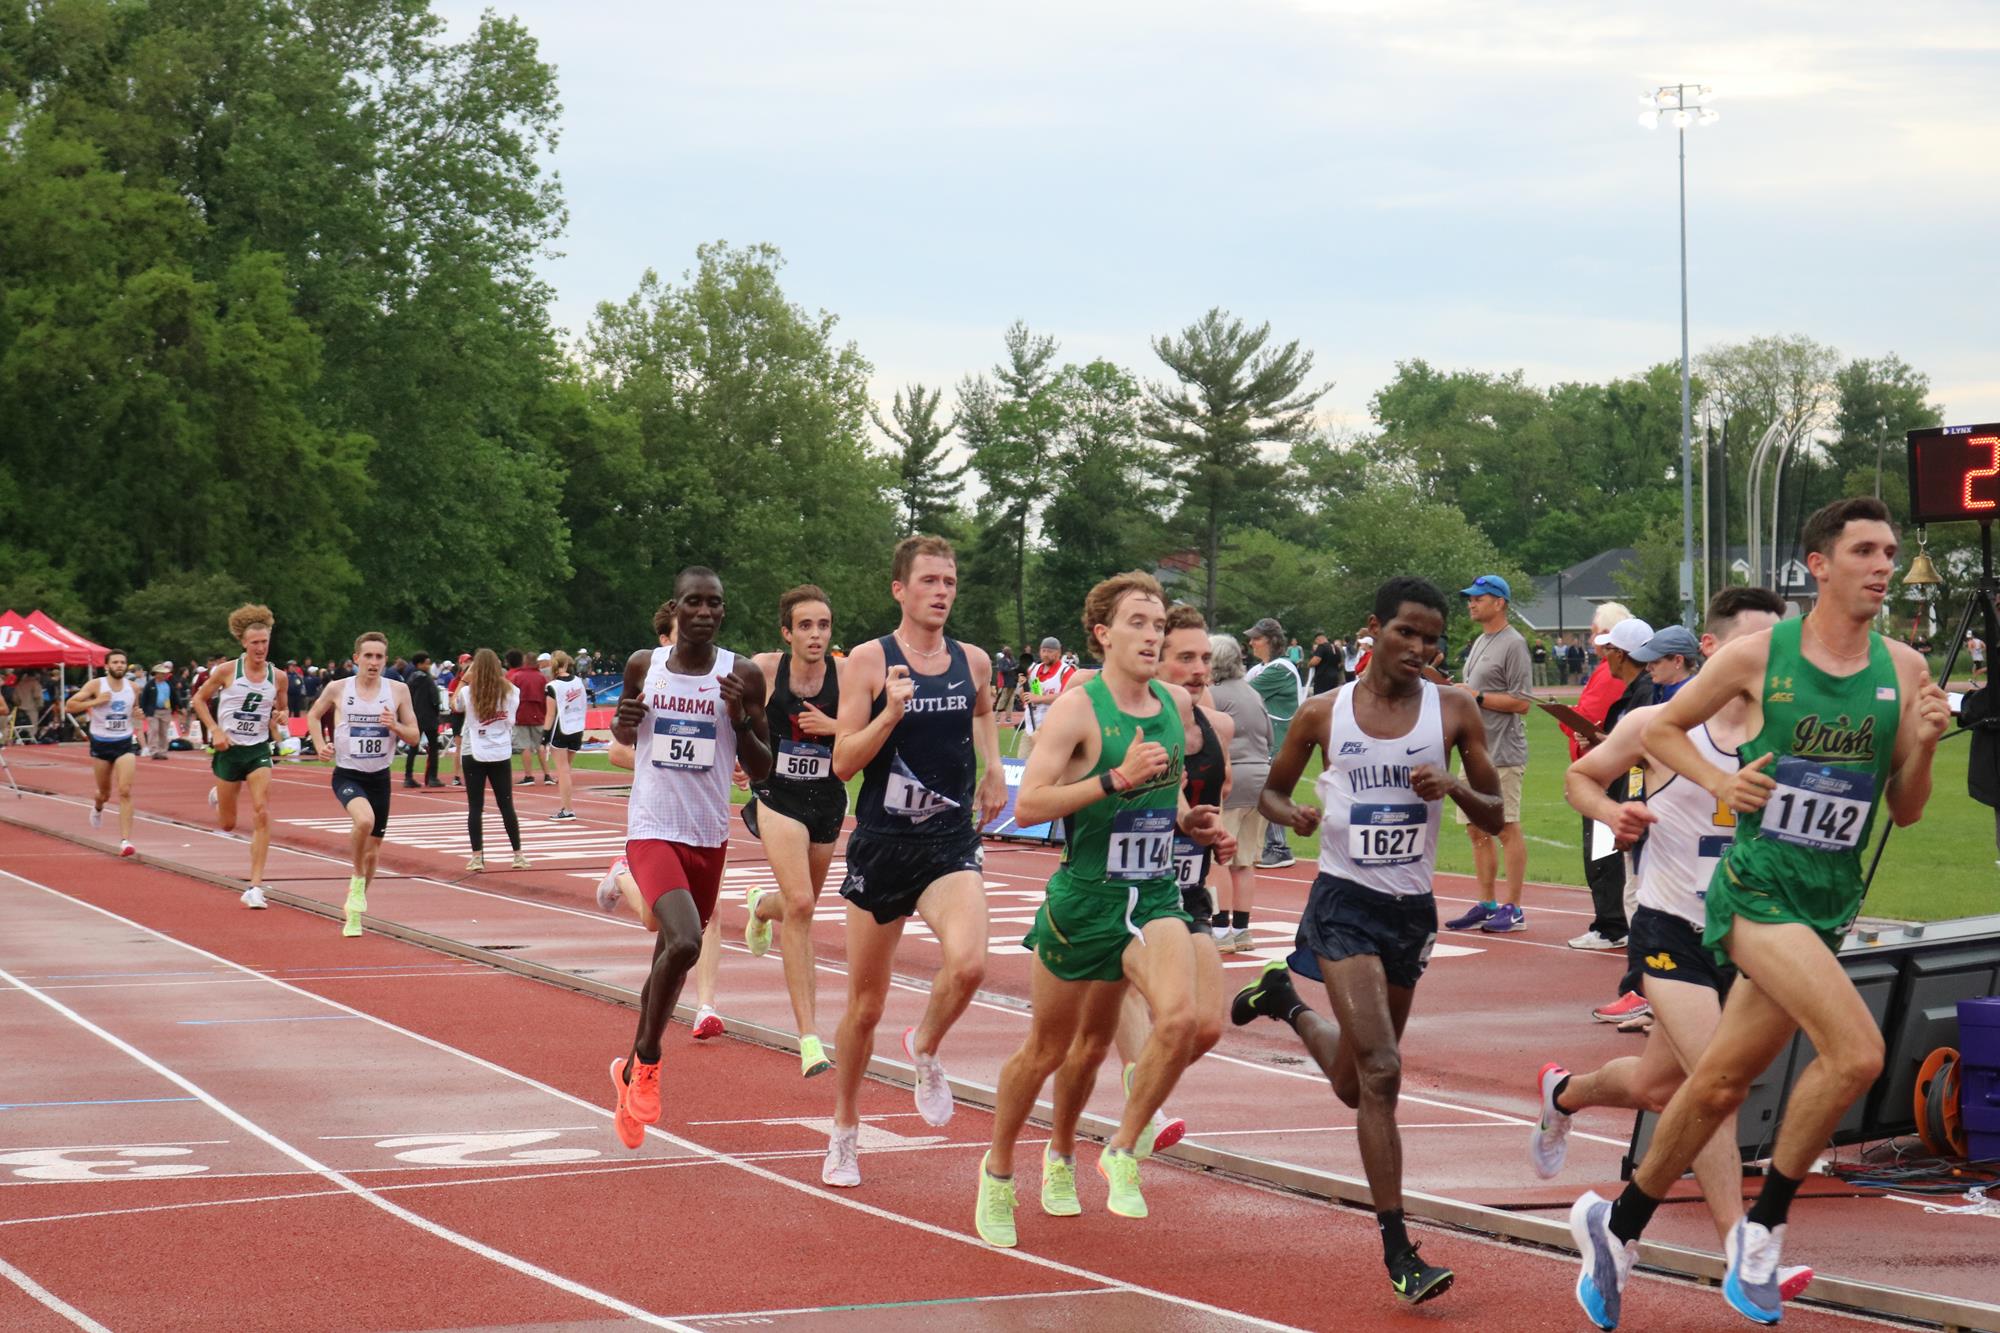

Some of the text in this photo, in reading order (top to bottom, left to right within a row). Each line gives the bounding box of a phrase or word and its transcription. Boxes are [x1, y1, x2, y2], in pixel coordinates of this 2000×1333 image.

[1951, 427, 1972, 435] LYNX
[1963, 436, 2000, 510] 2
[652, 694, 715, 716] ALABAMA
[903, 695, 968, 712] BUTLER
[236, 721, 256, 732] 202
[1793, 714, 1875, 756] Irish
[358, 739, 382, 753] 188
[669, 738, 695, 762] 54
[787, 757, 820, 775] 560
[1348, 765, 1413, 793] VILLANO
[1778, 793, 1860, 842] 1142
[1360, 828, 1419, 856] 1627
